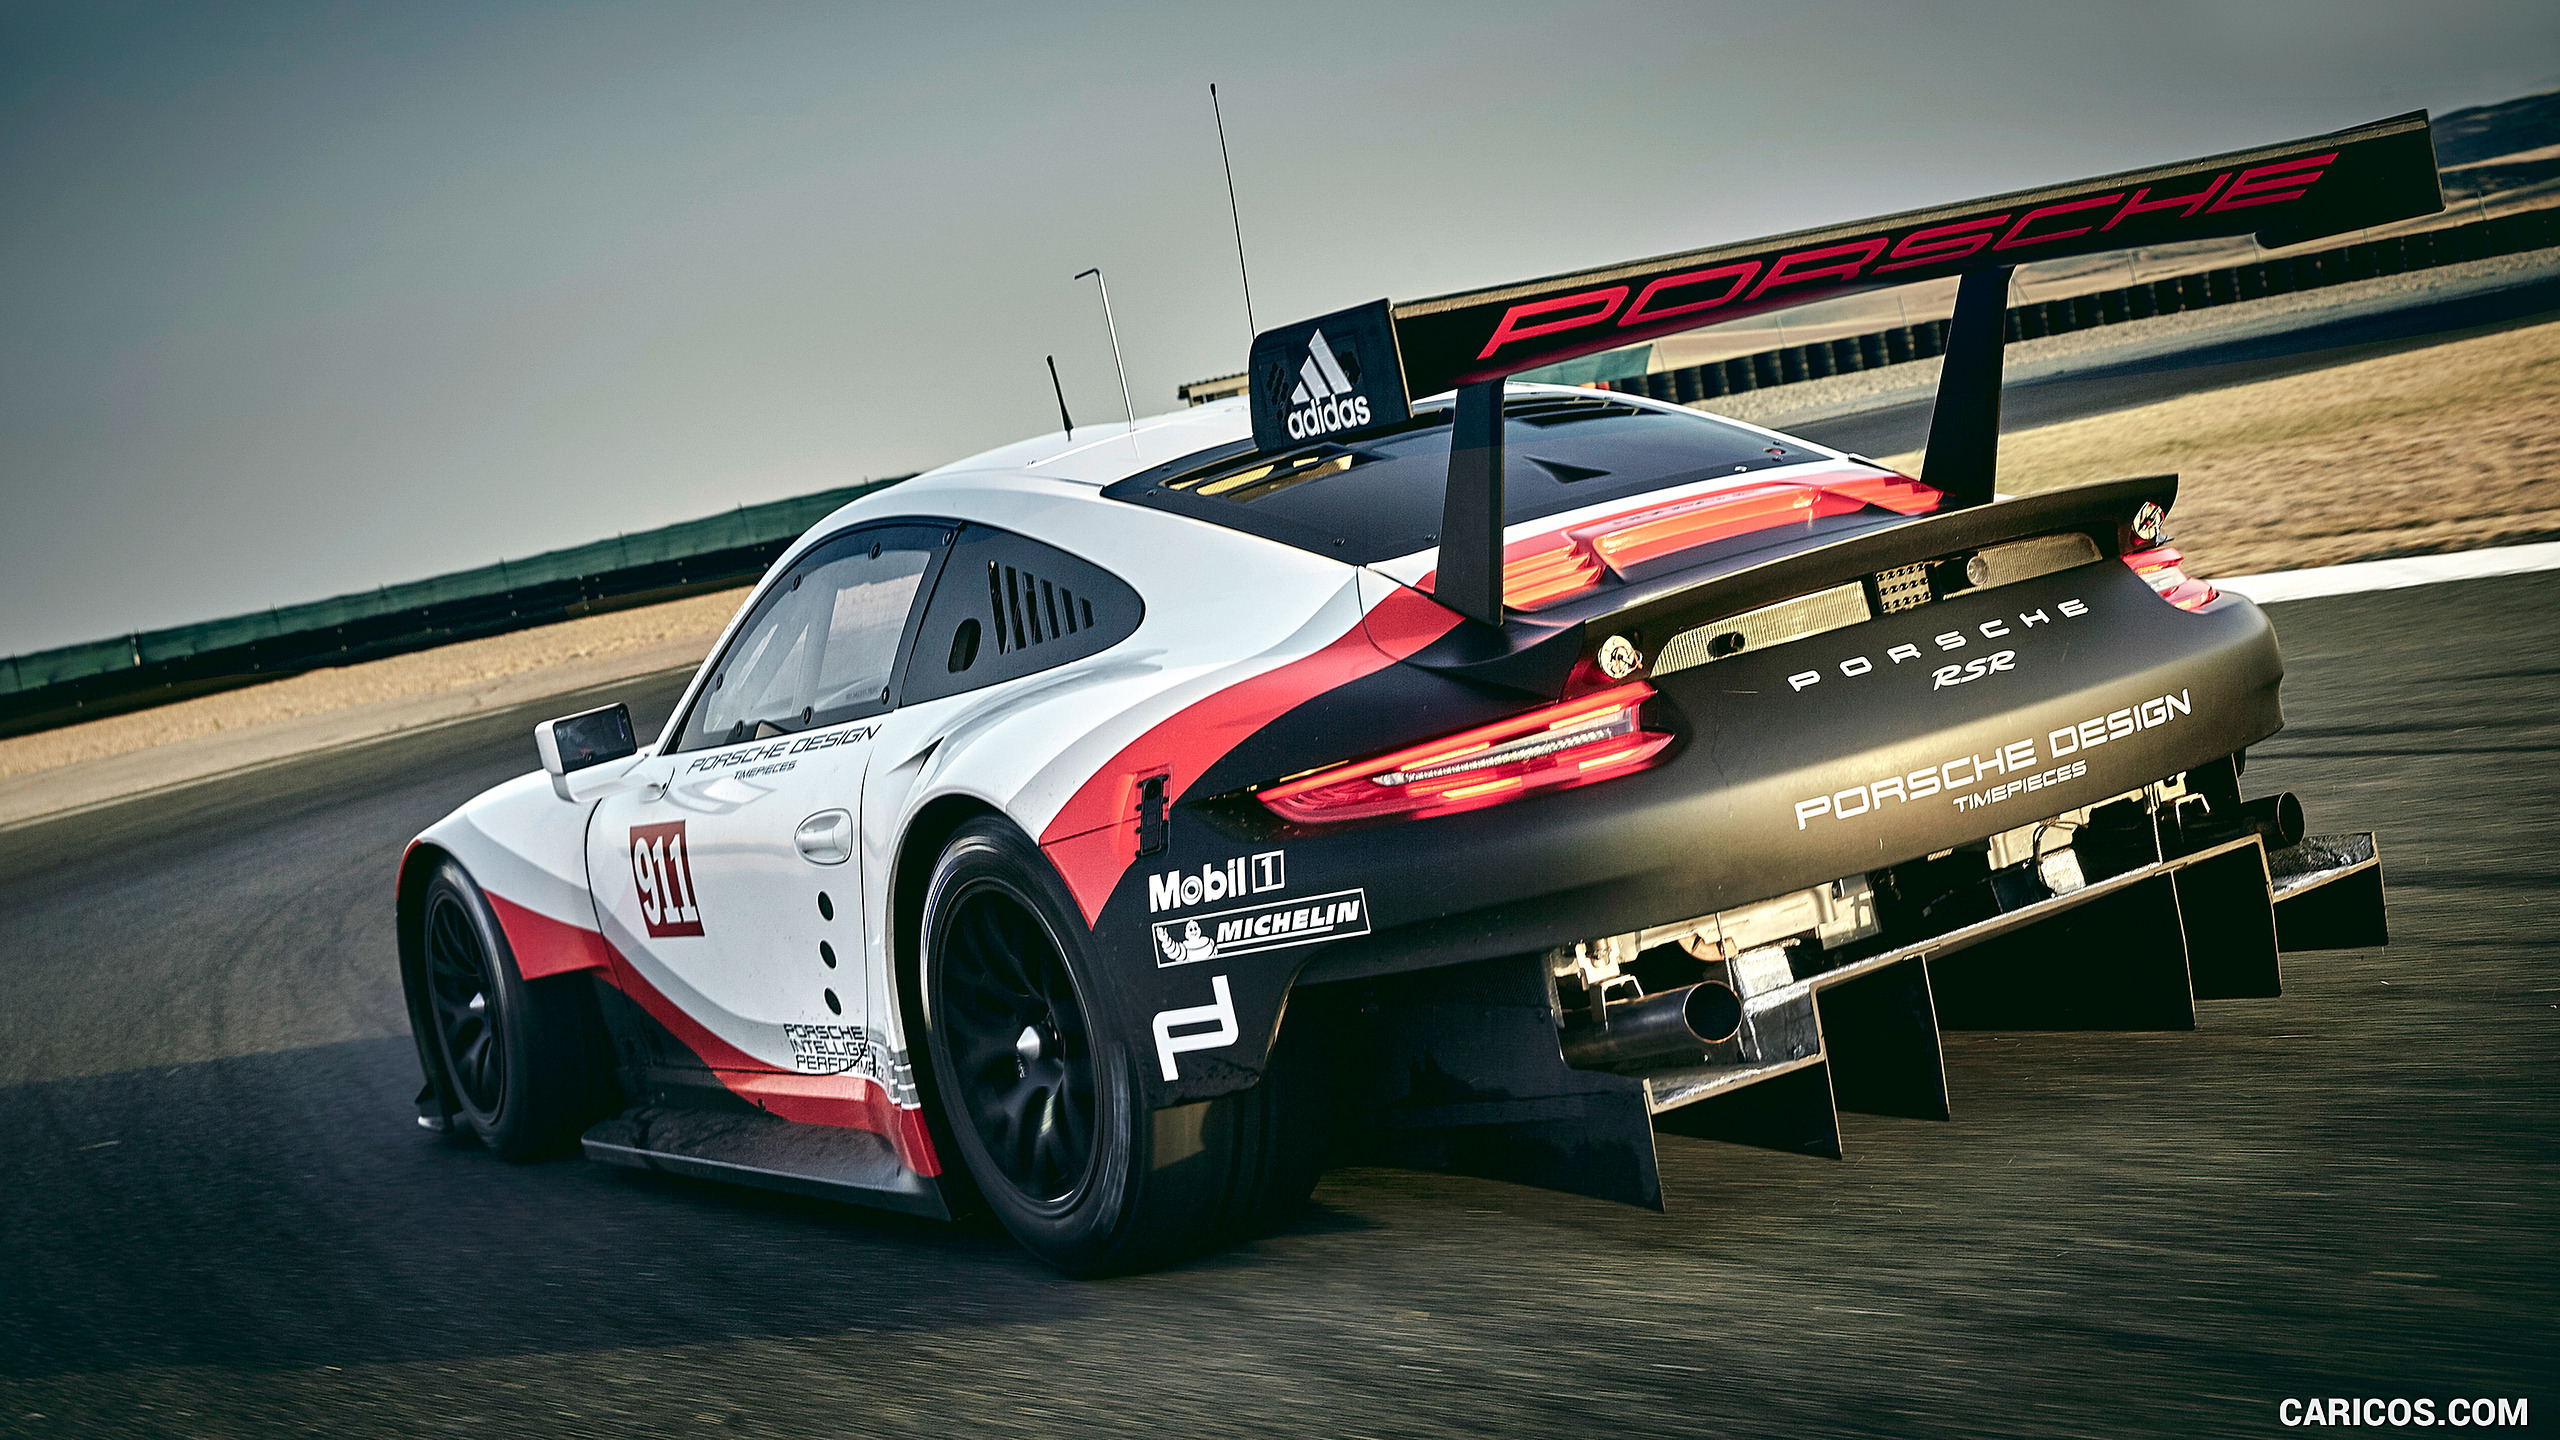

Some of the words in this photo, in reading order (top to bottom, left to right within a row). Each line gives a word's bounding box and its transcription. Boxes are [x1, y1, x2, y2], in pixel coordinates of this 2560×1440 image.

[1476, 152, 2339, 359] PORSCHE
[1287, 393, 1371, 440] adidas
[1787, 598, 2090, 693] PORSCHE
[1931, 649, 2016, 691] RSR
[686, 741, 790, 776] PORSCHE
[789, 723, 883, 755] DESIGN
[734, 760, 798, 781] TIMEPIECES
[1794, 737, 2037, 831] PORSCHE
[2048, 687, 2192, 760] DESIGN
[1952, 758, 2088, 813] TIMEPIECES
[633, 832, 699, 927] 911
[1149, 856, 1246, 913] Mobil
[1216, 899, 1361, 944] MICHELIN
[783, 1023, 865, 1040] PORSCHE
